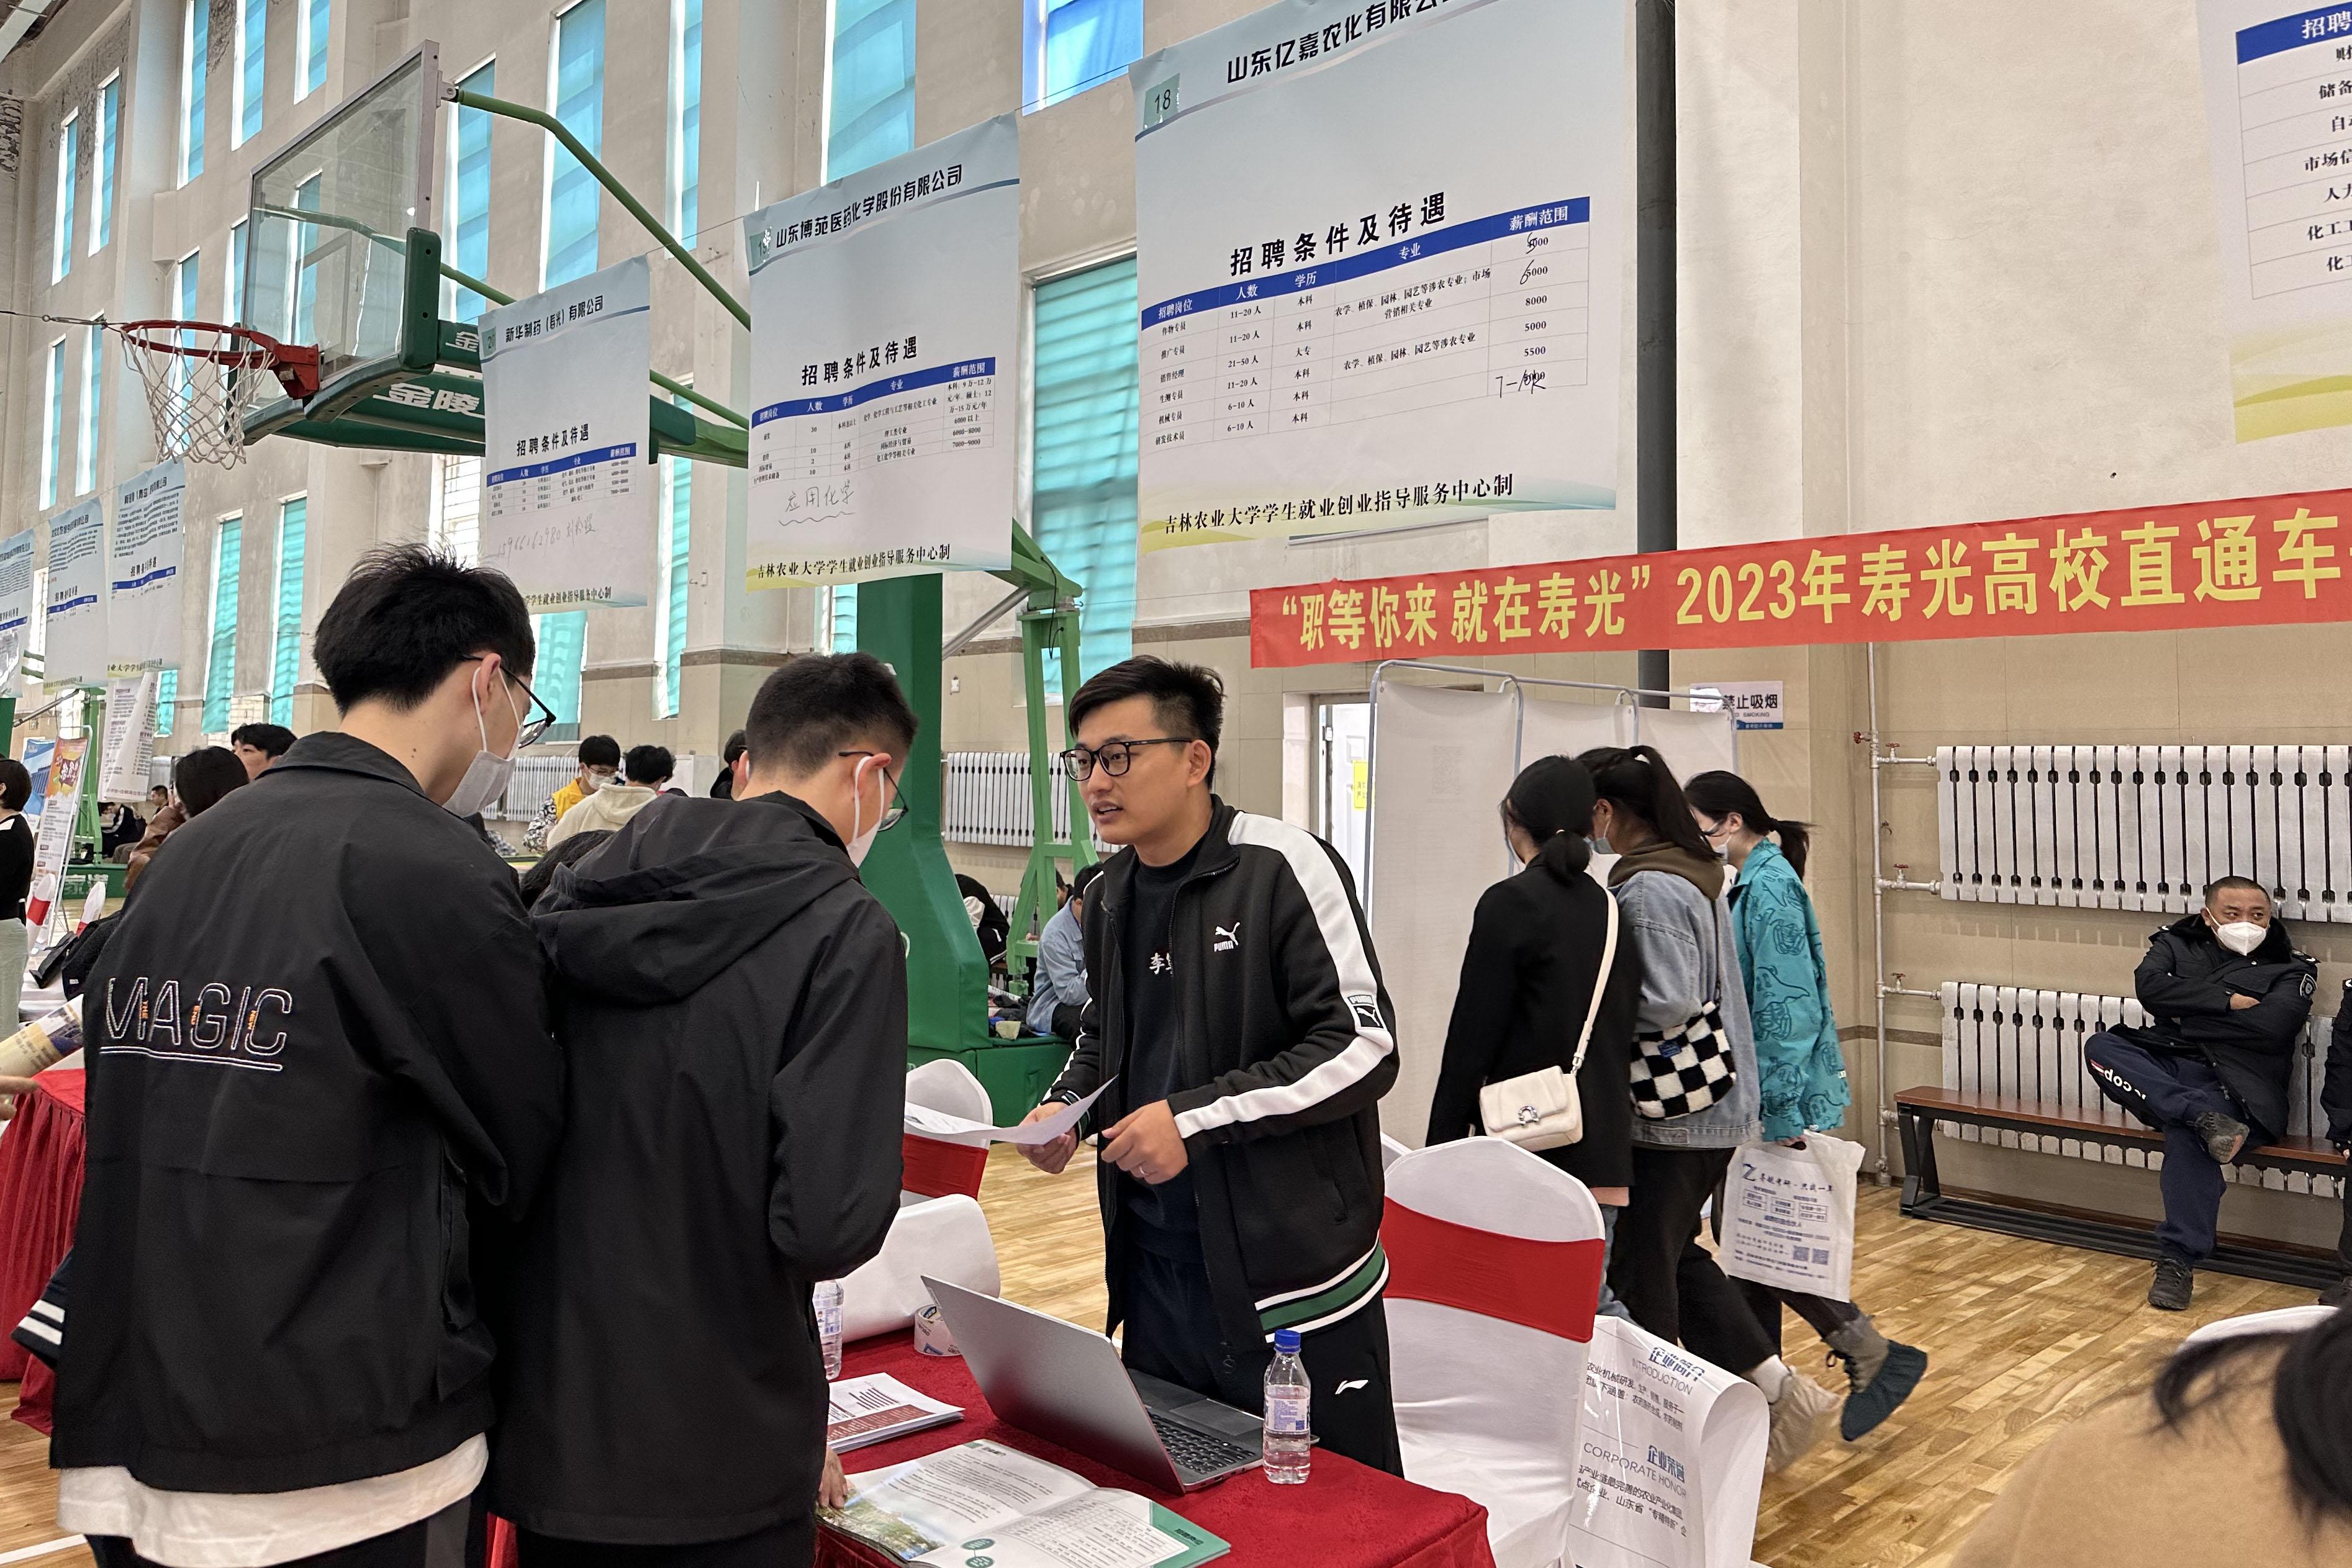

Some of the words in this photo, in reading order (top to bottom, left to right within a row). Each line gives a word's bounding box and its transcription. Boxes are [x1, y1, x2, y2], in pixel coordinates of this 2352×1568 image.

[1227, 0, 1450, 84] 山东亿嘉农化有限
[1154, 89, 1172, 114] 18
[2332, 116, 2352, 132] 自
[1231, 191, 1447, 277] 招聘条件及待遇
[2308, 220, 2352, 241] 化工
[1159, 299, 1193, 319] 招聘岗位
[1236, 284, 1259, 300] 人数
[1295, 271, 1317, 287] 学历
[1398, 242, 1421, 260] 专业
[1509, 205, 1568, 231] 薪酬范围
[1298, 294, 1313, 307] 本科
[1525, 295, 1547, 306] 8000
[1296, 320, 1312, 332] 本科
[802, 336, 917, 386] 招聘条件及待遇
[1295, 367, 1310, 379] 本科
[1524, 320, 1547, 331] 5000
[1293, 390, 1309, 402] 本科
[1524, 346, 1546, 357] 5500
[807, 400, 823, 412] 人数
[890, 379, 903, 391] 专业
[1291, 412, 1308, 424] 本科
[517, 423, 589, 457] 招聘条件及待遇
[1165, 473, 1513, 534] 吉林农业大学学生就业创业指导服务中心制
[757, 543, 951, 579] 吉林农业大学学生就业创业指导服务中心制
[1675, 508, 2352, 626] 2023年寿光高校直通车
[1214, 940, 1234, 952] PUMA
[1583, 1442, 1657, 1483] CORPORATE
[1658, 1476, 1688, 1501] HONOR
